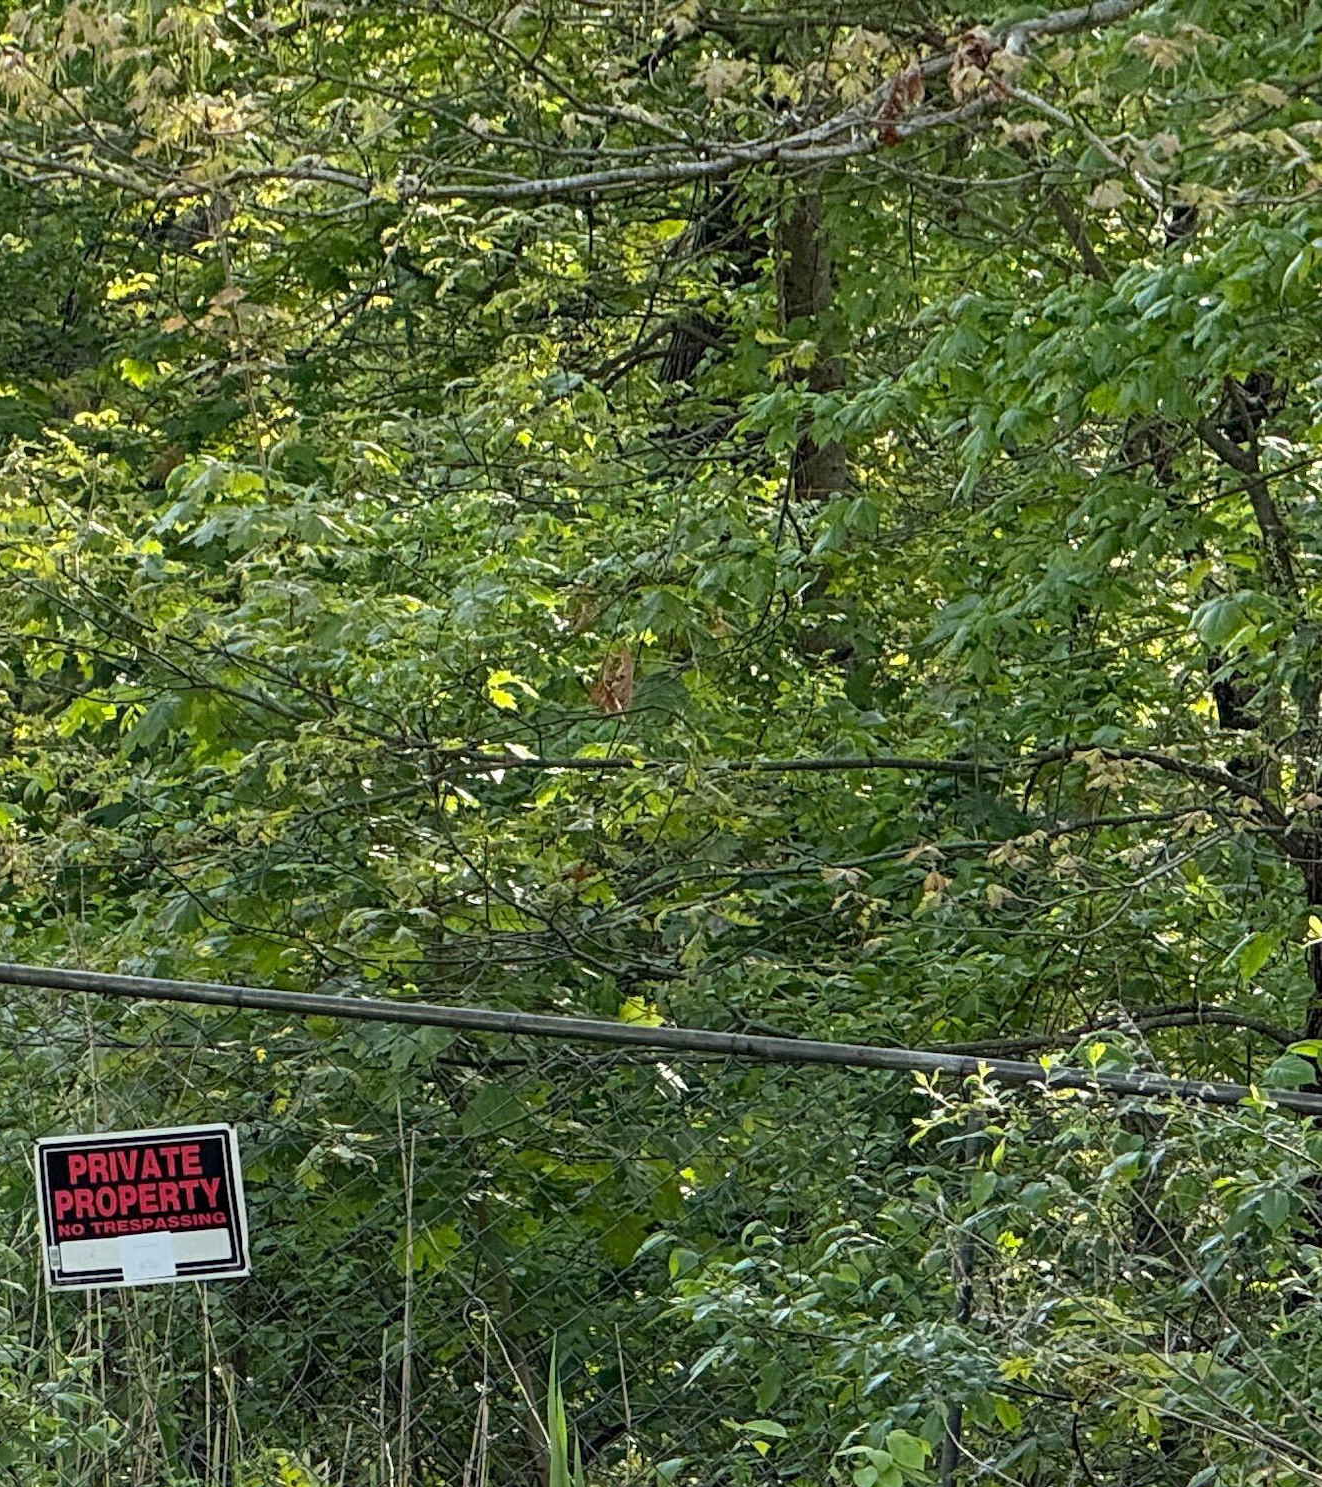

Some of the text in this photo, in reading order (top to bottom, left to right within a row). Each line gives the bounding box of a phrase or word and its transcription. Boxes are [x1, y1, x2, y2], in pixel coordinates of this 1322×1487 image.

[68, 1145, 203, 1185] PRIVATE
[55, 1177, 221, 1220] PROPERTY
[58, 1211, 227, 1237] NO TRESPASSING
